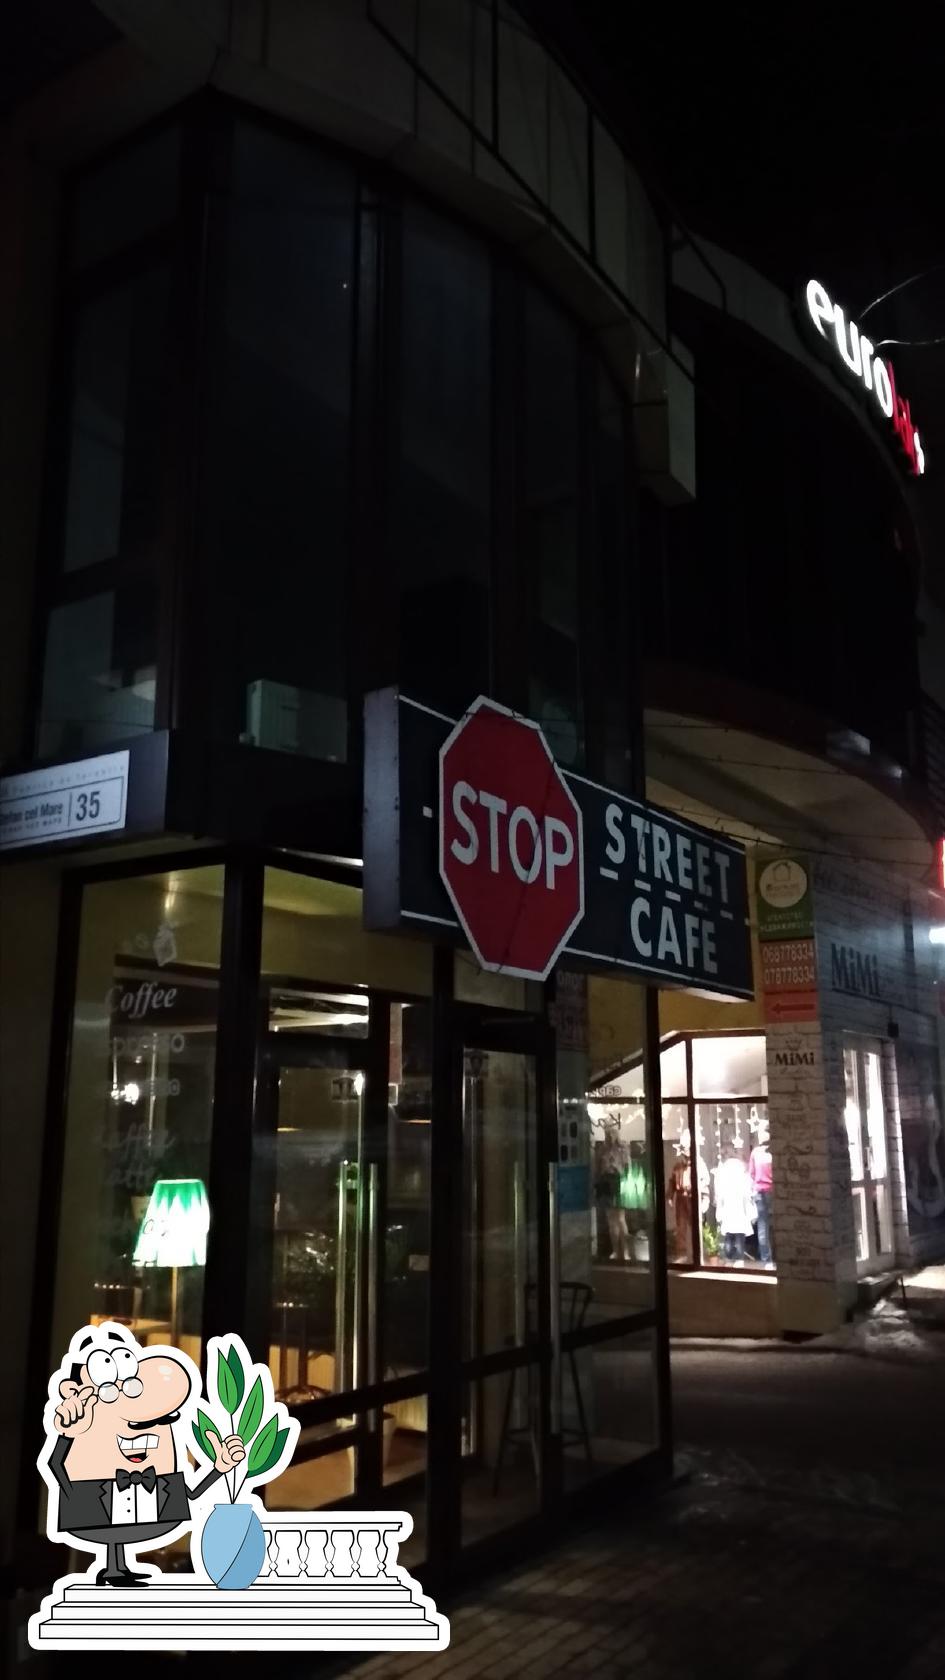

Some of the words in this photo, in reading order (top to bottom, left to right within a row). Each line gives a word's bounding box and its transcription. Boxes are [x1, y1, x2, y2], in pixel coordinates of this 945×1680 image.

[76, 791, 101, 821] 35
[450, 780, 574, 890] STOP
[604, 803, 730, 904] STREET
[630, 896, 719, 975] CAFE
[762, 943, 815, 963] 068778334
[764, 966, 816, 985] 078778334
[831, 942, 881, 998] MiMi
[103, 982, 178, 1020] Coffee
[774, 1051, 815, 1066] MiMi
